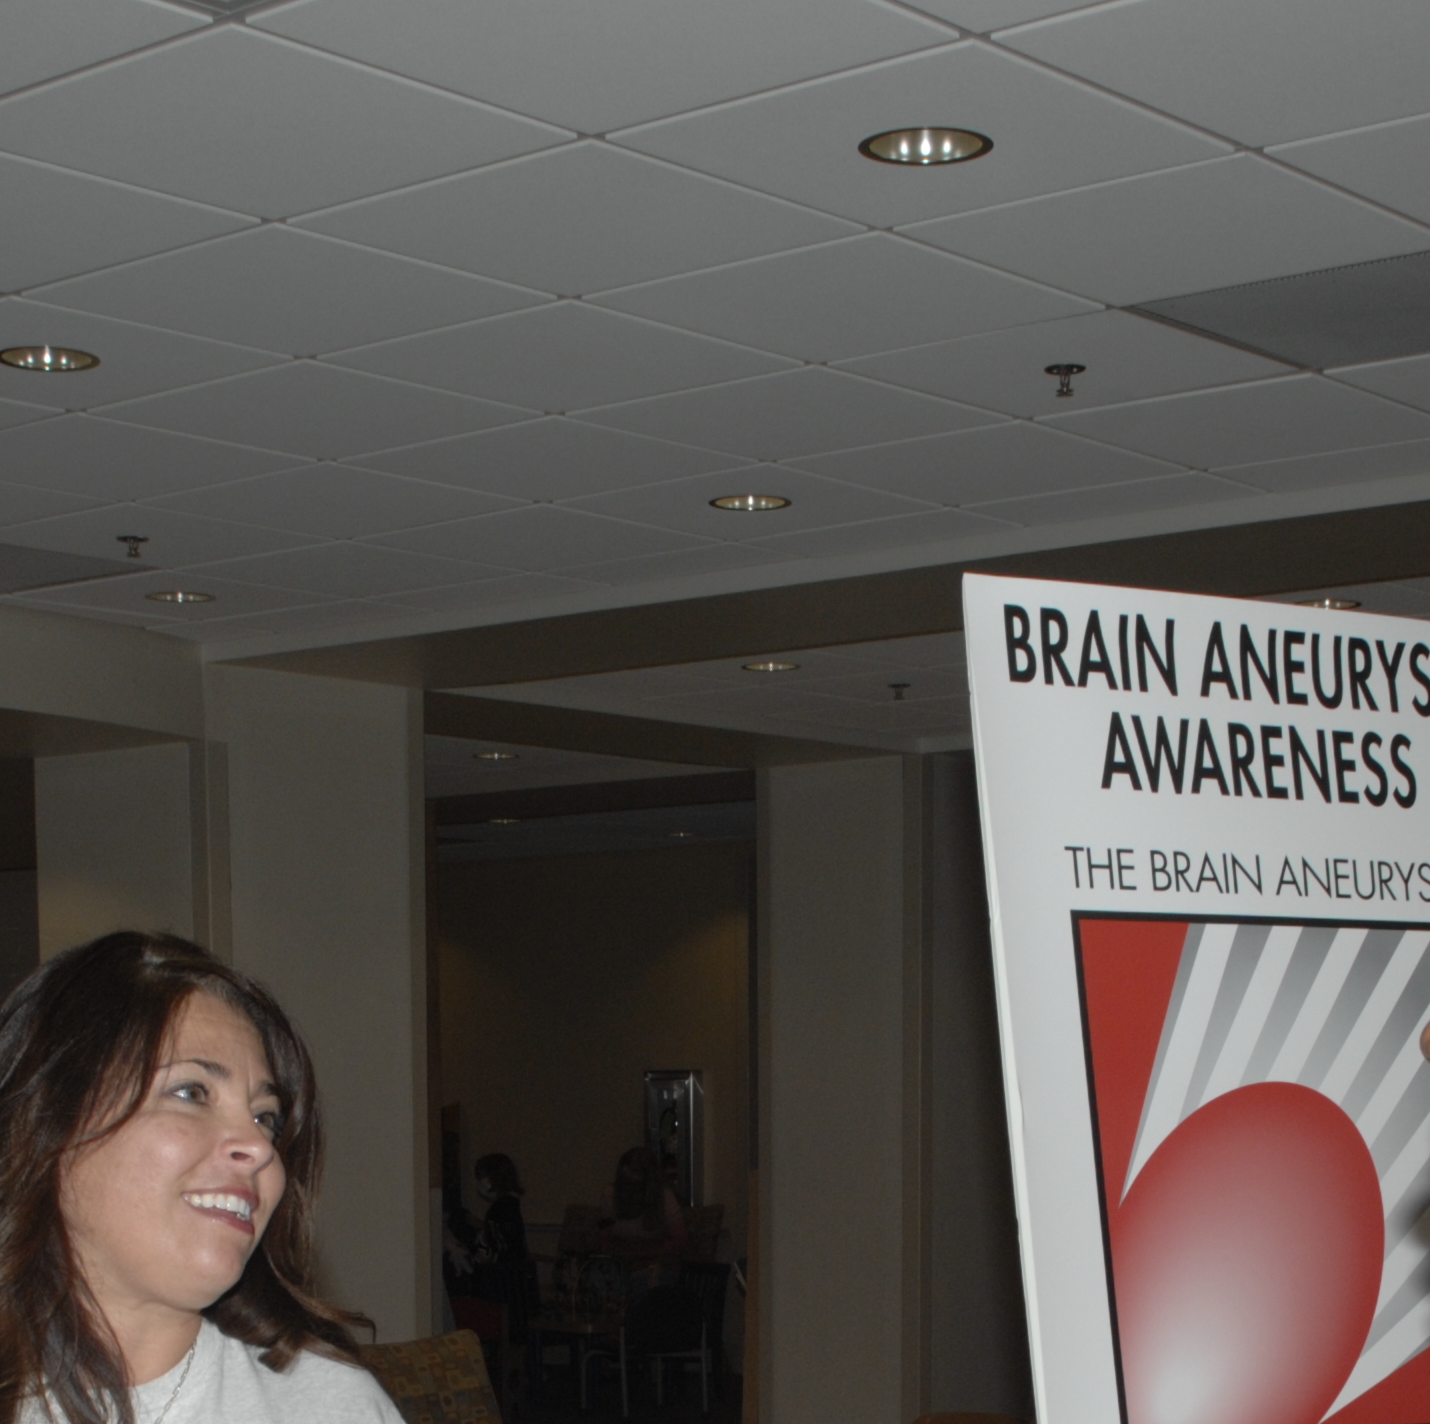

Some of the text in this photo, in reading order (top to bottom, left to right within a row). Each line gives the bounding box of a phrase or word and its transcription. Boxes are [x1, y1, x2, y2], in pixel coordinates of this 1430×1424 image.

[1003, 603, 1178, 697] BRAIN
[1101, 711, 1418, 809] AWARENESS
[1064, 845, 1138, 892] THE
[1151, 850, 1263, 896] BRAIN
